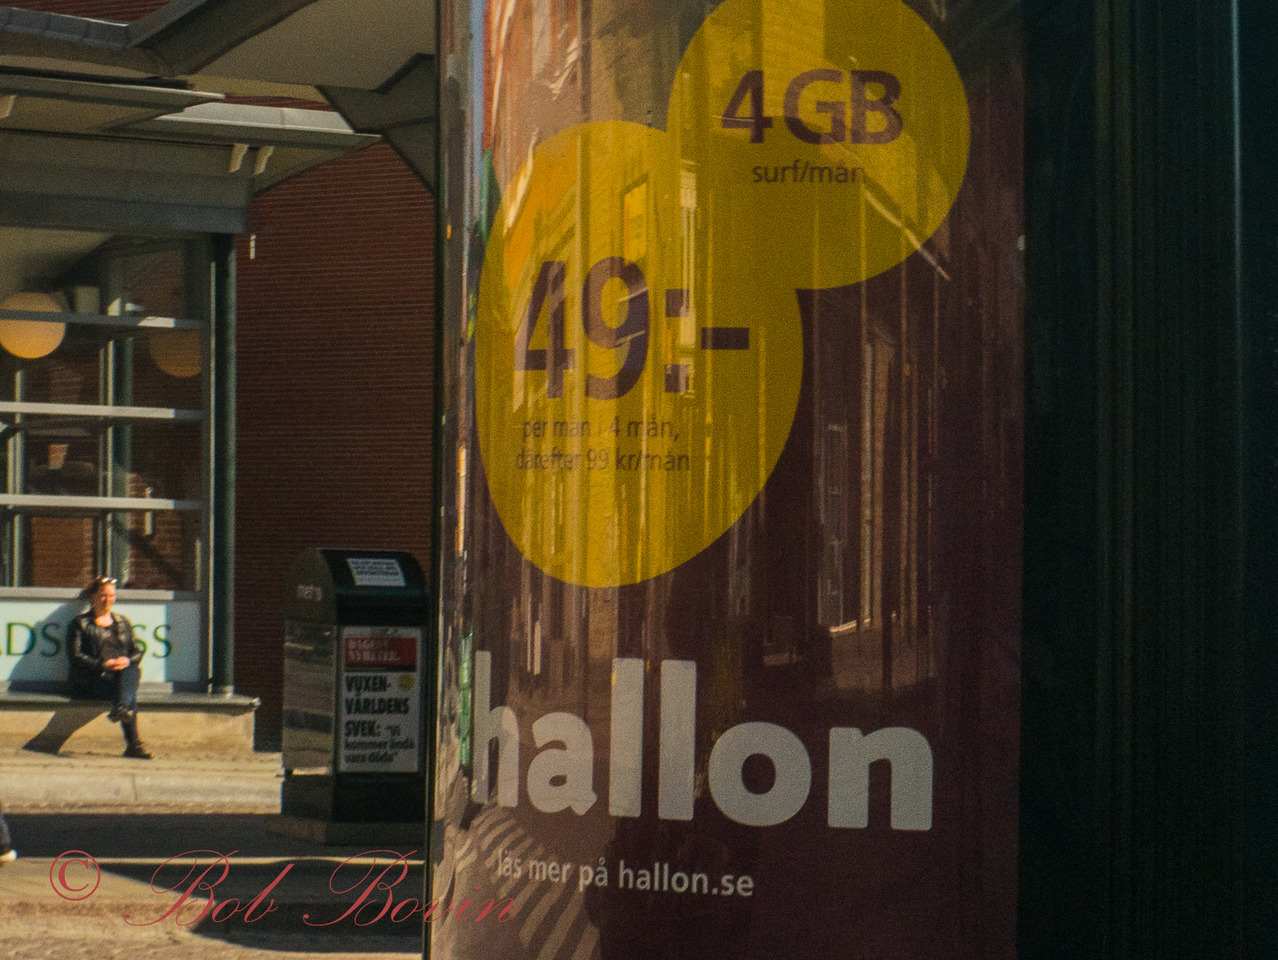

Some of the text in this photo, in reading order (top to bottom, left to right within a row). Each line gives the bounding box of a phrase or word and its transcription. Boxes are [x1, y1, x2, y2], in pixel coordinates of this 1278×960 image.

[752, 159, 867, 184] surf/mån
[514, 256, 749, 400] 49:-
[609, 415, 622, 437] 4
[627, 414, 680, 442] mån,
[585, 448, 609, 471] 99
[615, 446, 690, 471] kr/mån
[473, 650, 933, 830] hallon
[528, 857, 571, 883] mer
[579, 857, 608, 891] på
[619, 859, 754, 897] hallon.se
